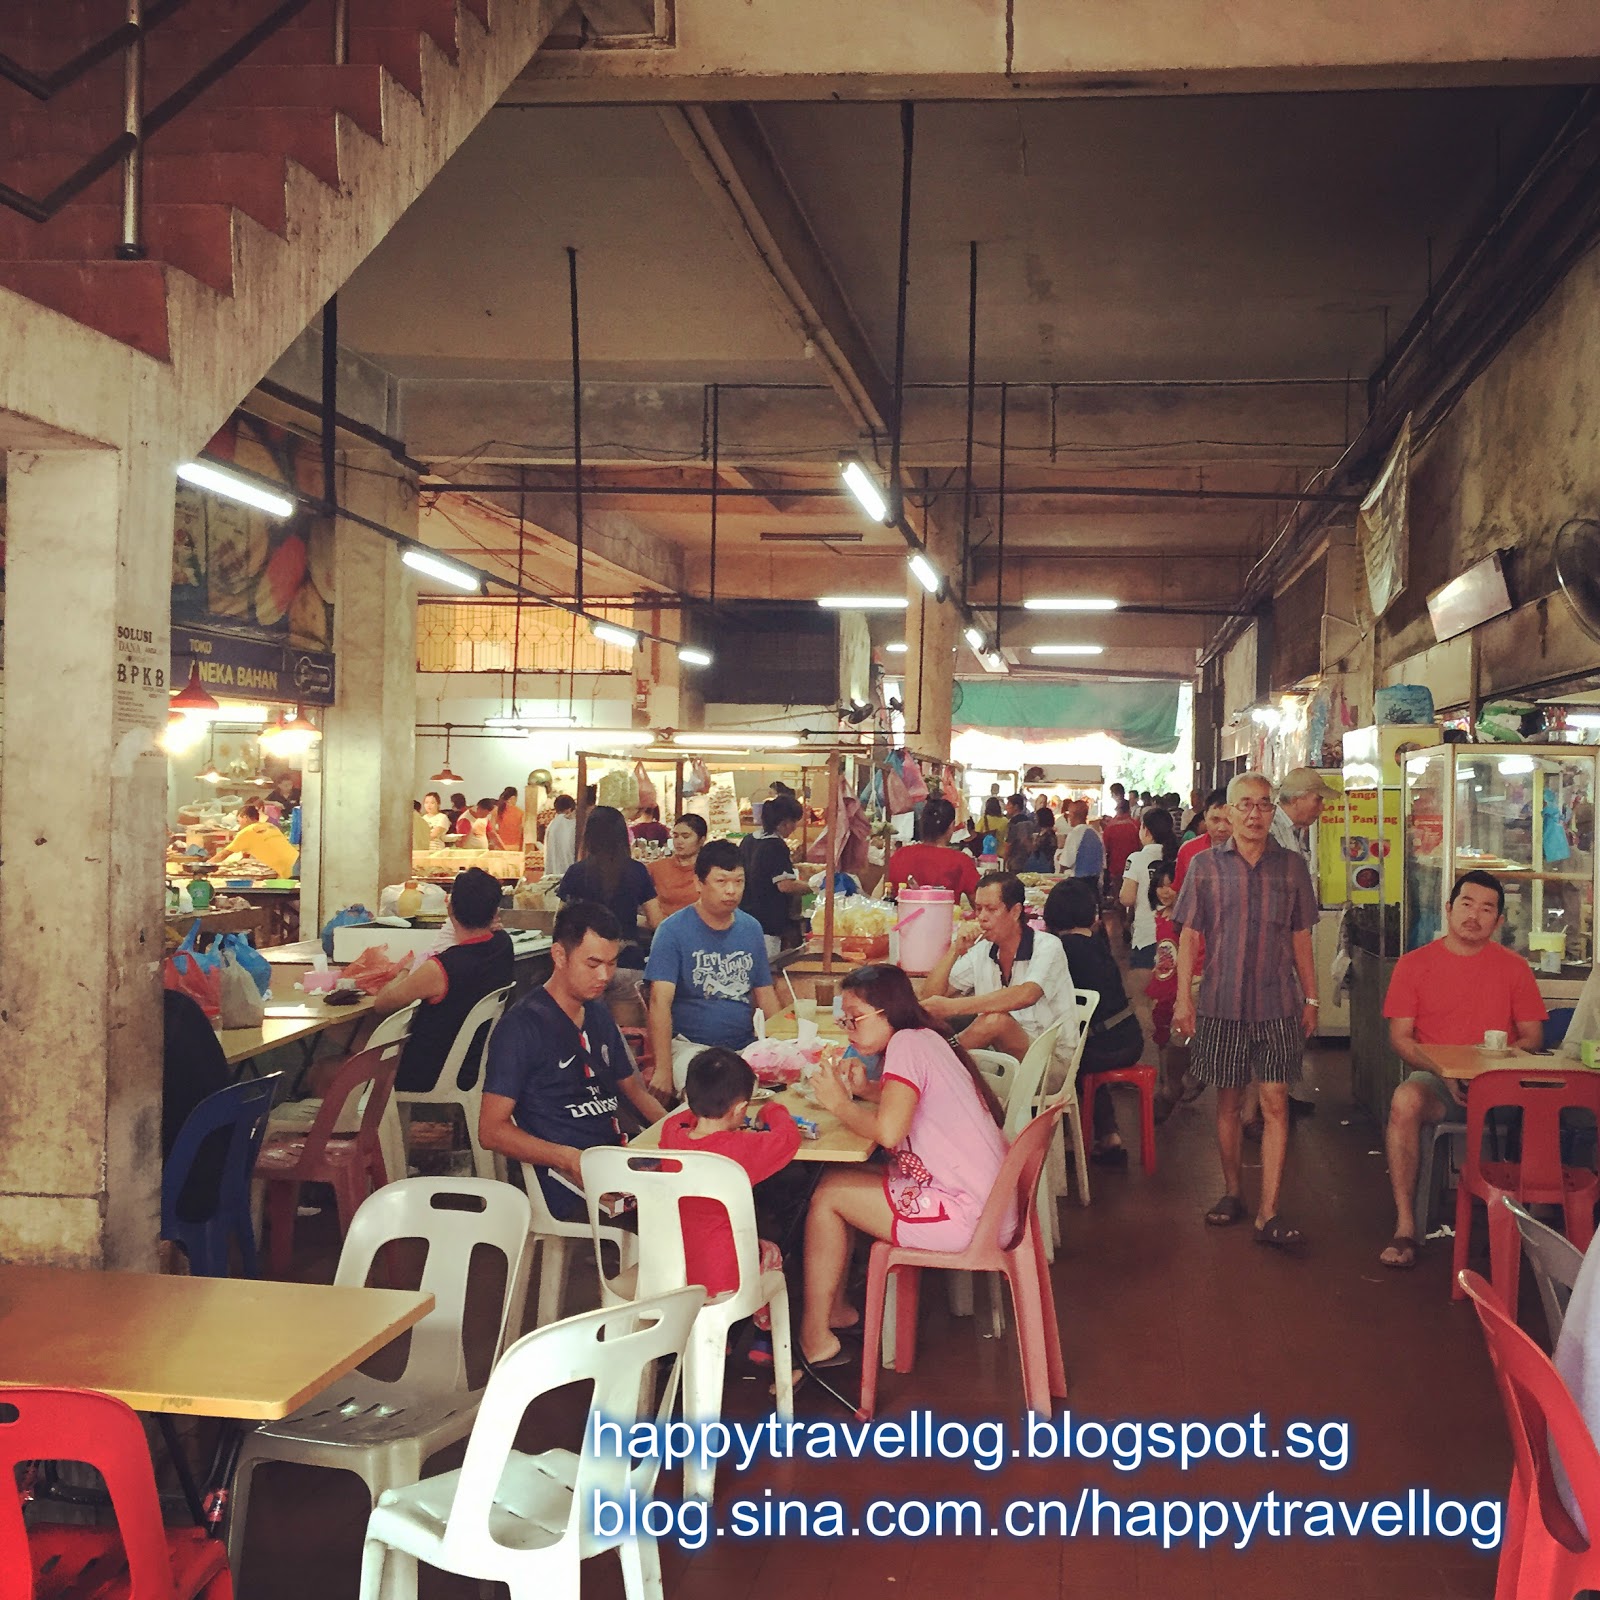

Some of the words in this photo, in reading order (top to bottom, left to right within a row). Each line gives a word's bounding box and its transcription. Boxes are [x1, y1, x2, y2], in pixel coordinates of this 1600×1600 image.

[117, 625, 152, 643] SOLUSI
[190, 638, 213, 654] TOKO
[237, 666, 278, 689] BAHAN
[1321, 815, 1347, 824] Sela
[1352, 815, 1398, 825] Panjng
